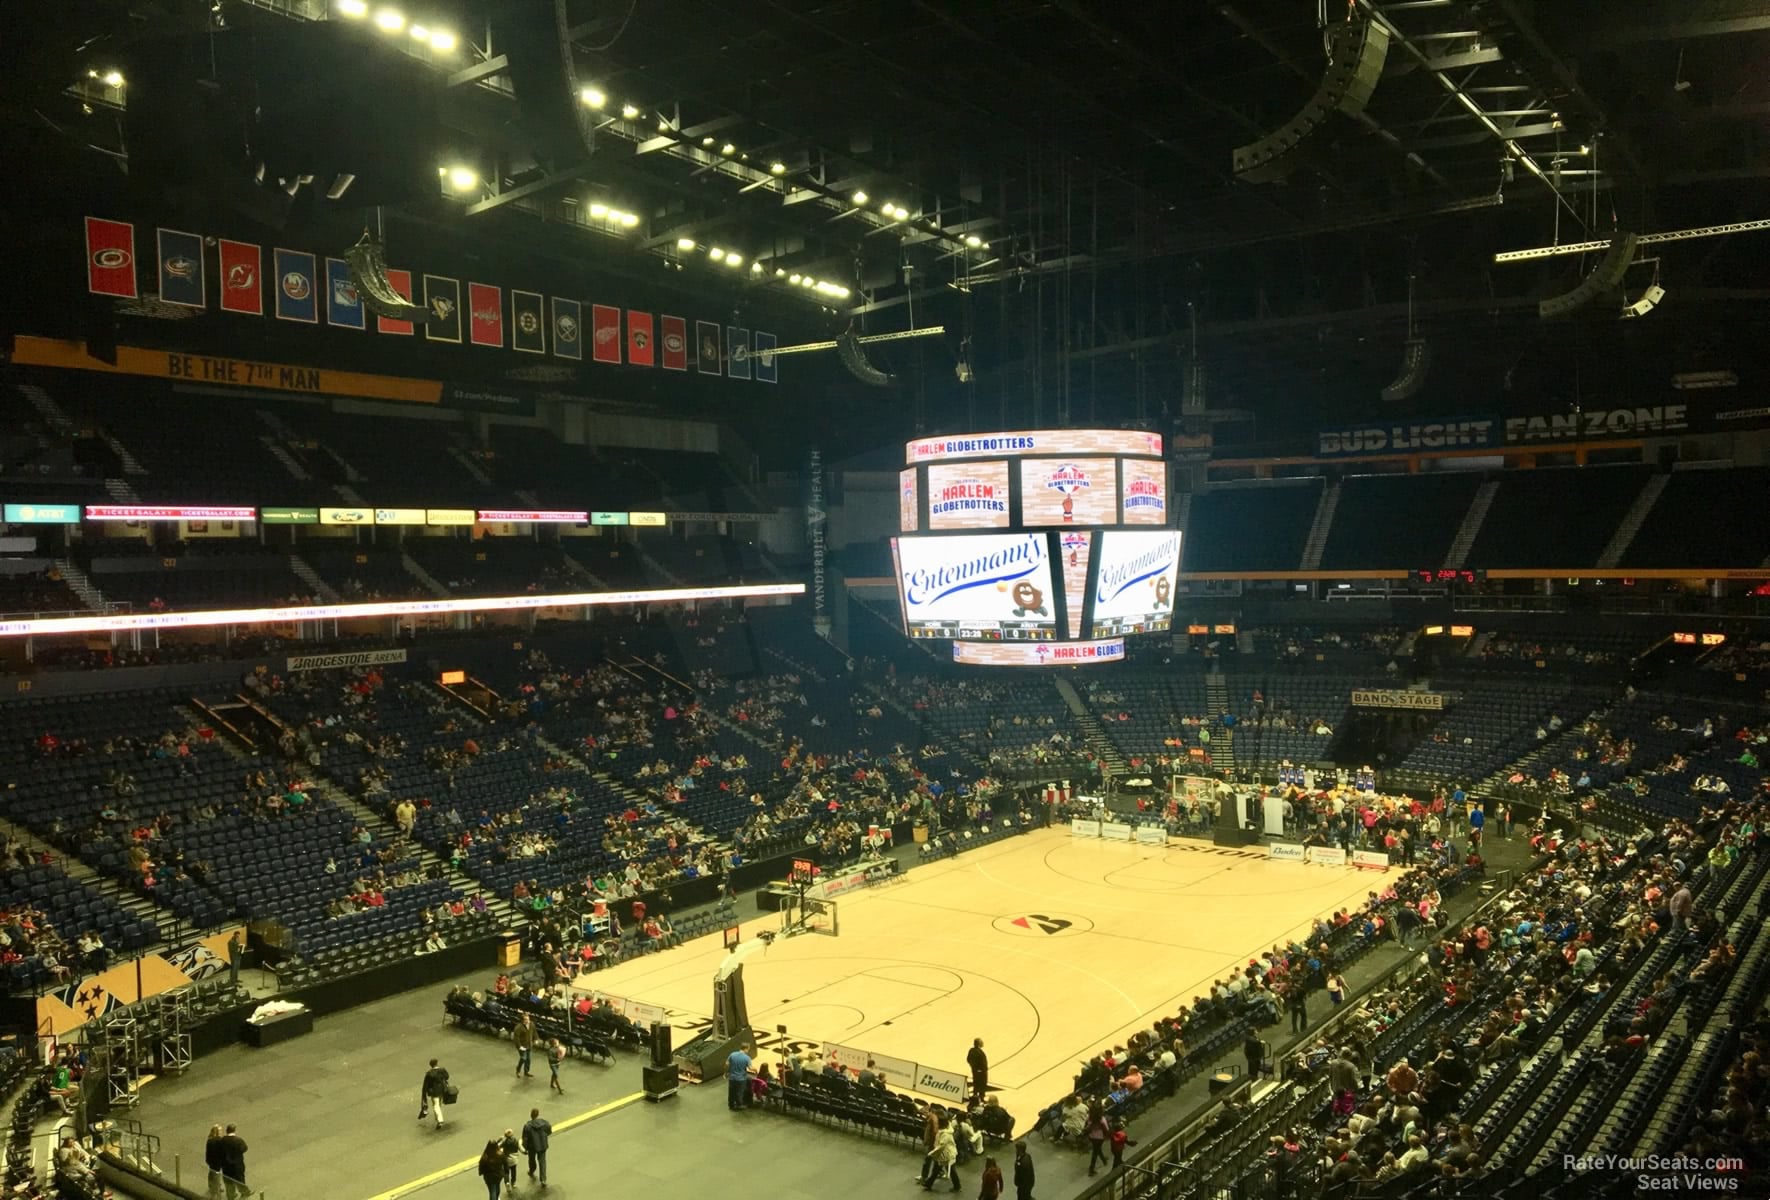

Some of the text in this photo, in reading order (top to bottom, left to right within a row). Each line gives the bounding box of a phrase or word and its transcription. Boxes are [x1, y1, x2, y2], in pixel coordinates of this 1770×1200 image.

[168, 354, 320, 391] BE THE 7TH MAN
[1319, 404, 1689, 453] BUD LIGHT FAN ZONE
[917, 436, 1035, 456] HARLEM GLOBETROTTERS
[811, 450, 822, 502] HEALTH
[1048, 479, 1090, 488] GLOBETROTTERS
[1053, 471, 1084, 480] HARLEM
[942, 484, 994, 500] HARLEM
[1130, 481, 1158, 496] HARLEM
[933, 499, 1005, 514] GLOBETROTTERS
[1125, 495, 1164, 509] GLOBETROTTERS
[813, 529, 825, 609] VANDERBILT
[293, 651, 403, 669] BRIDGESTONE ARENA
[1054, 646, 1095, 658] HARLEM
[1354, 693, 1440, 706] BAND STAGE
[919, 1073, 961, 1095] Baden
